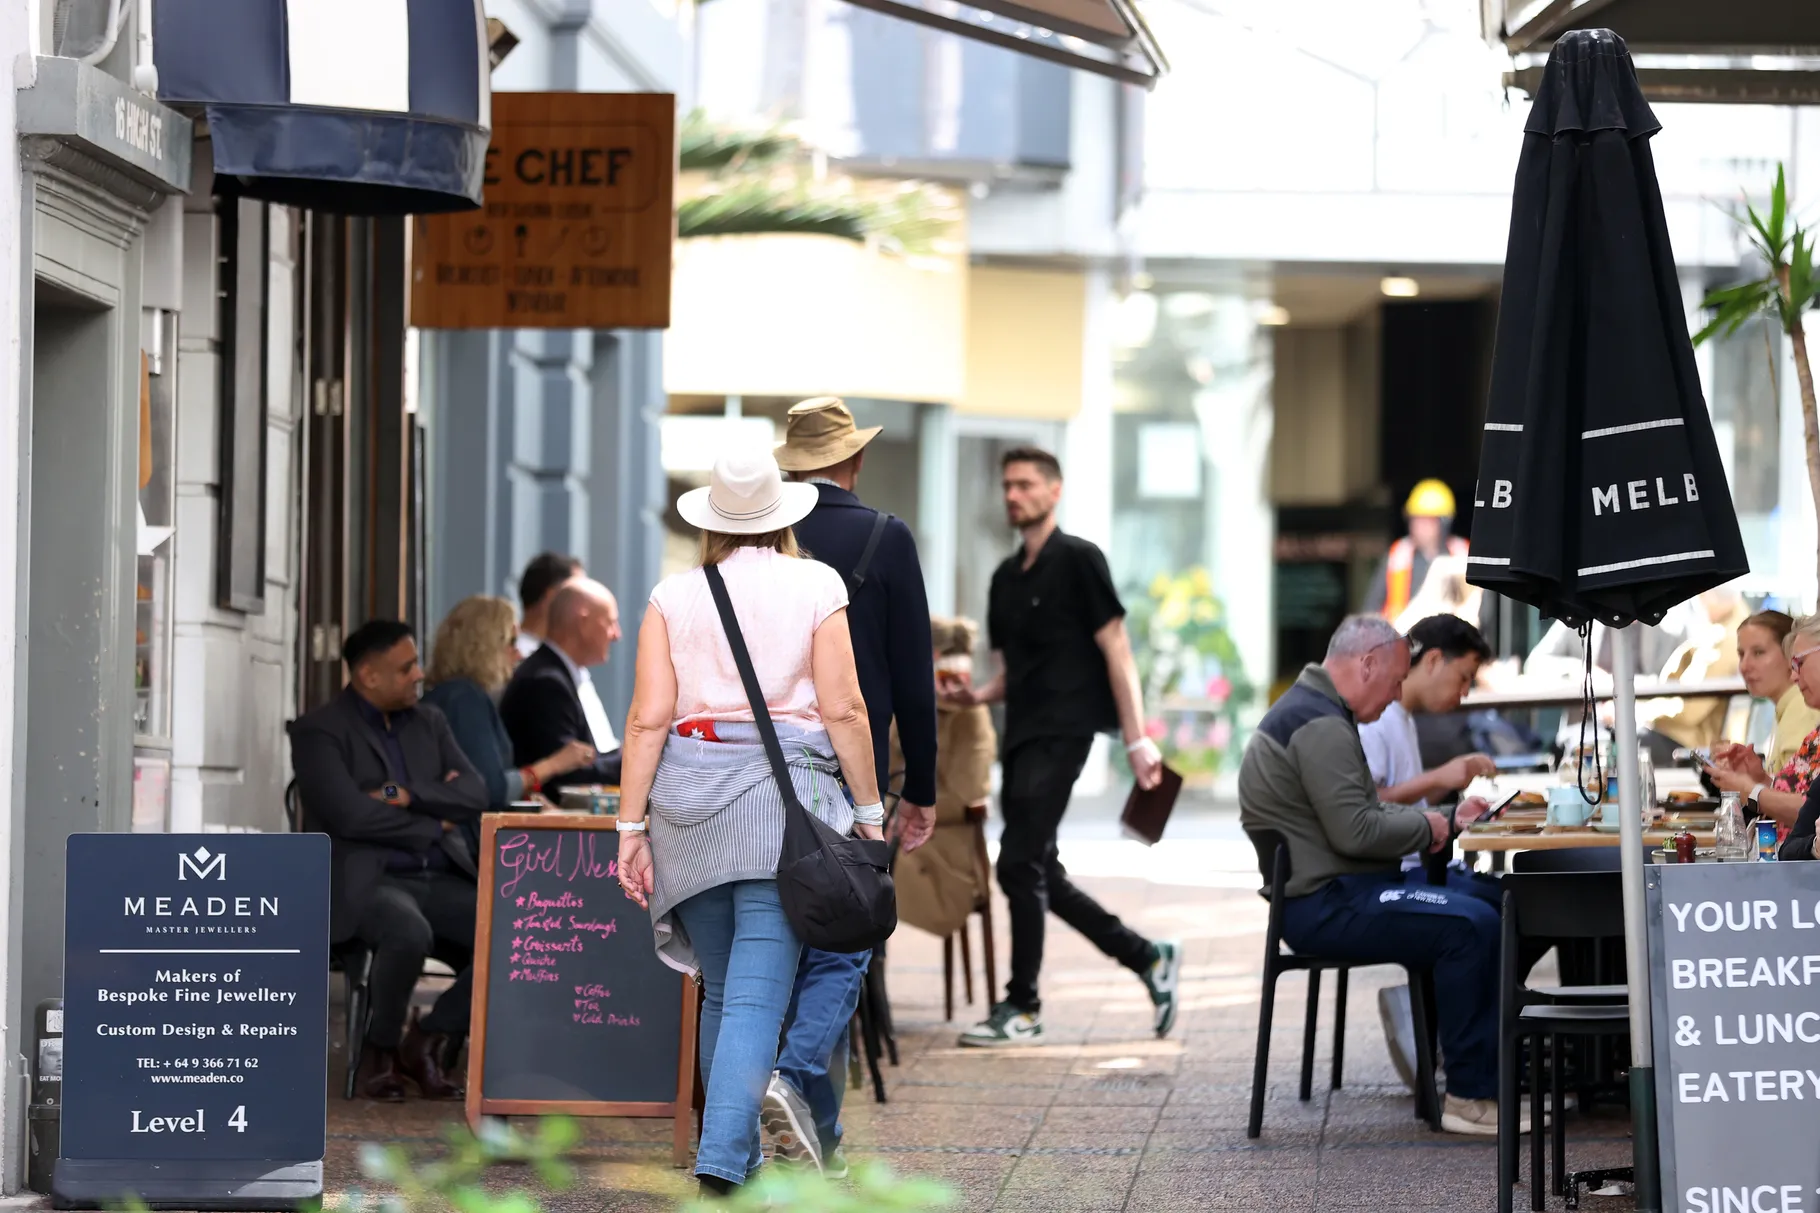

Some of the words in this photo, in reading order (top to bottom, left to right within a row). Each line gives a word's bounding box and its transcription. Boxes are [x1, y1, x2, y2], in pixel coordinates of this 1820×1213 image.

[115, 96, 125, 140] 16
[515, 147, 632, 186] CHEF
[1591, 473, 1700, 516] MELB
[500, 833, 563, 898] Girl
[568, 830, 620, 882] Nex
[124, 896, 279, 916] MEADEN
[1669, 900, 1778, 933] YOUR
[1791, 899, 1820, 929] L
[146, 926, 190, 934] MASTER
[195, 926, 257, 935] JEWELLERS
[155, 969, 217, 983] Makers
[223, 968, 242, 983] of
[1672, 956, 1820, 990] BREAKF
[97, 988, 169, 1006] Bespoke
[175, 988, 211, 1002] Fine
[216, 988, 297, 1006] Jewellery
[96, 1023, 156, 1036] Custom
[162, 1023, 216, 1039] Design
[221, 1023, 234, 1036] &
[239, 1023, 298, 1039] Repairs
[1675, 1015, 1702, 1047] &
[1715, 1012, 1820, 1045] LUNC
[136, 1058, 160, 1069] TEL:
[163, 1060, 171, 1068] +
[174, 1058, 189, 1069] 64
[191, 1058, 200, 1069] 9
[202, 1058, 224, 1069] 366
[226, 1058, 240, 1069] 71
[244, 1058, 259, 1069] 62
[151, 1072, 244, 1084] www.meaden.co
[130, 1109, 206, 1133] Level
[227, 1105, 248, 1133] 4
[1685, 1184, 1804, 1213] SINCE
